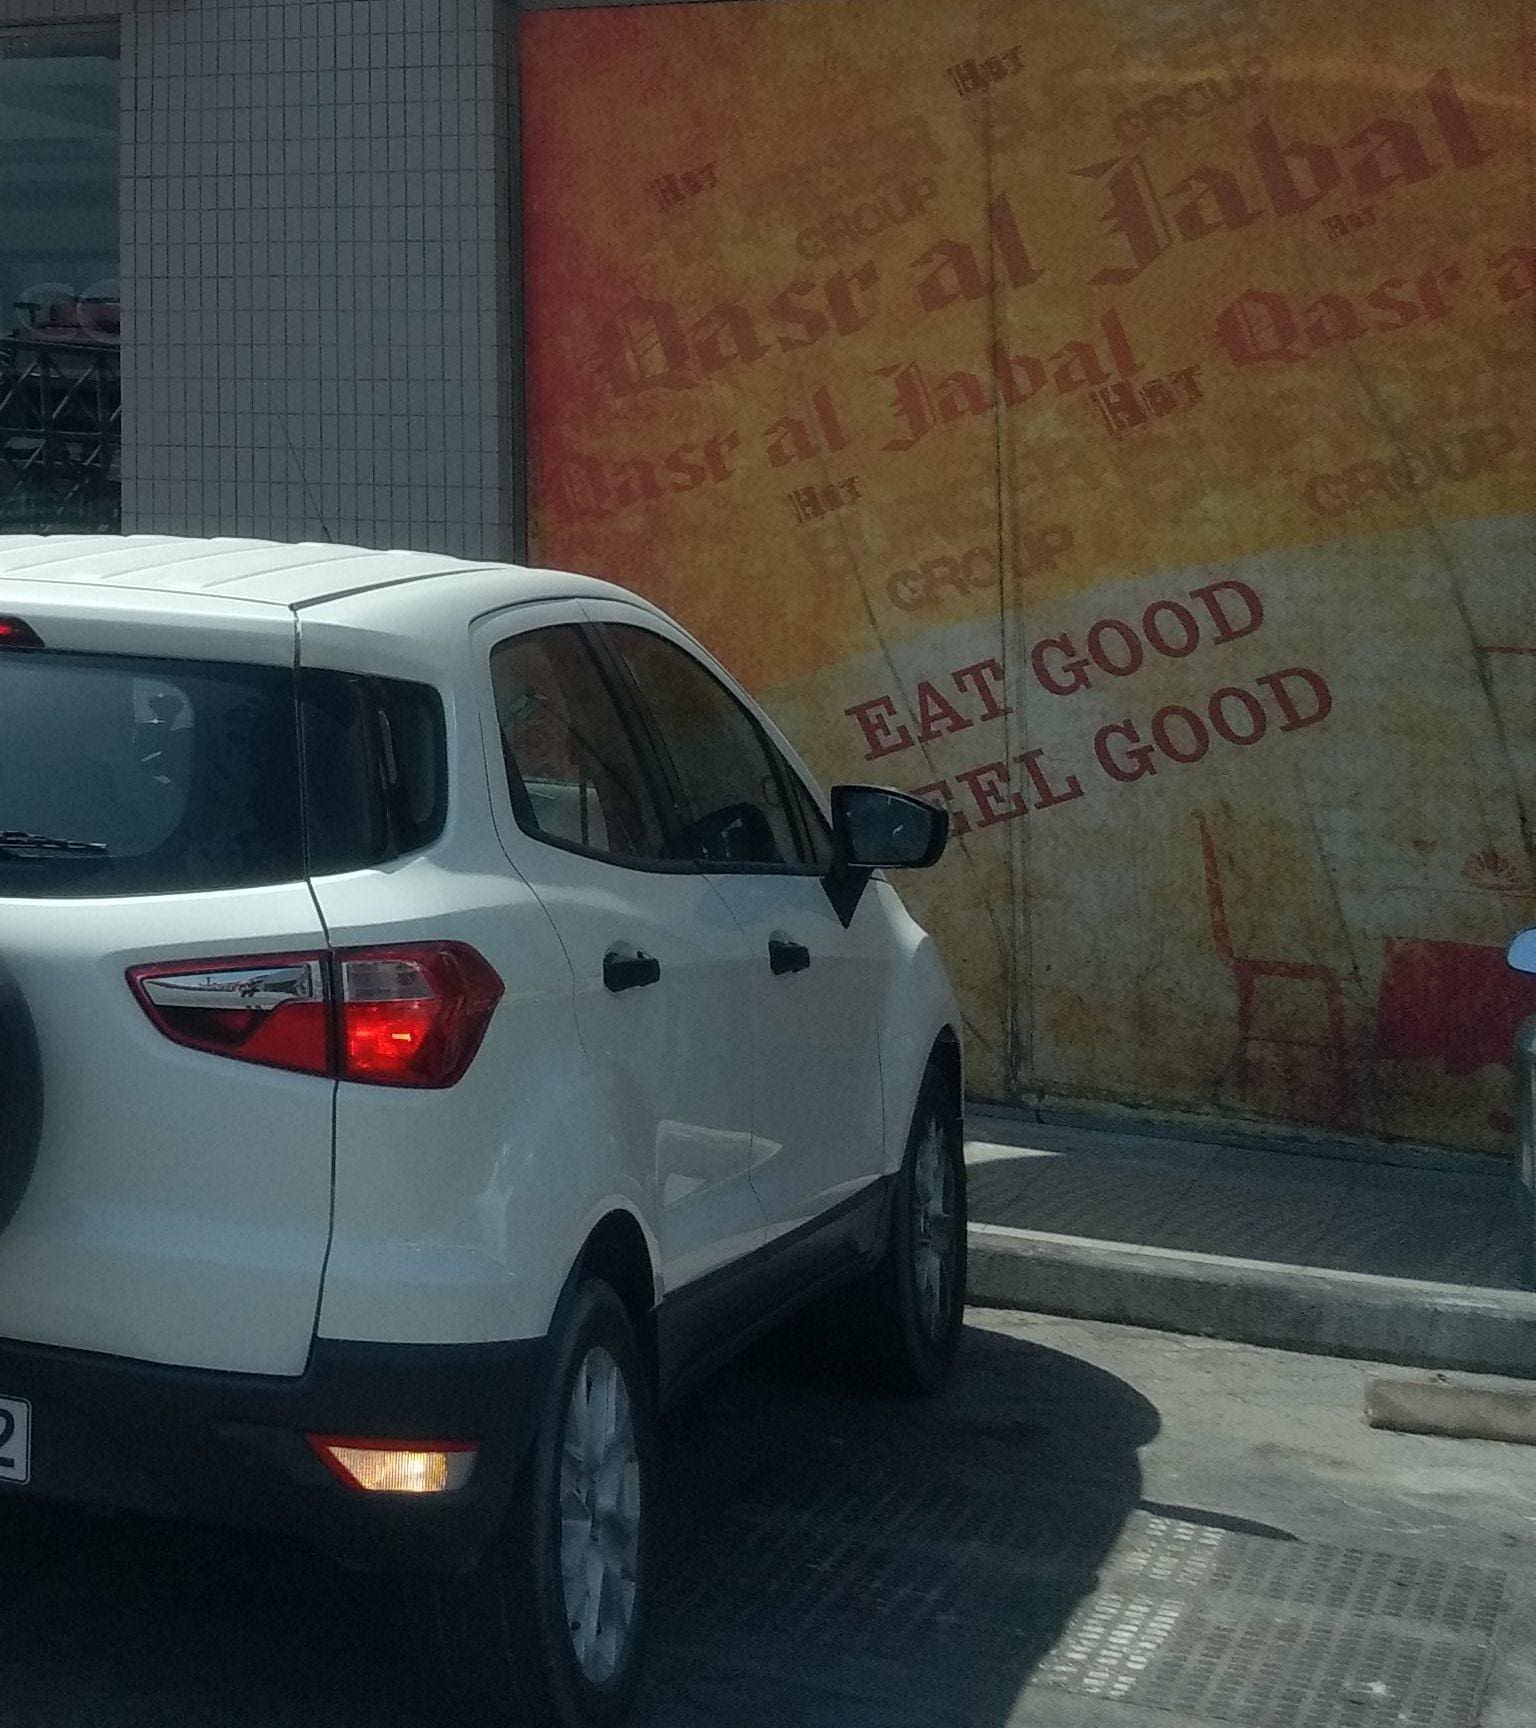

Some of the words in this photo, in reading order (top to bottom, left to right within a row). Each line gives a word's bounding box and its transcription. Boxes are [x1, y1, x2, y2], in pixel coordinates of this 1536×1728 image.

[591, 255, 882, 401] Qasr
[914, 190, 1044, 316] al
[1071, 66, 1494, 287] Jabal
[1209, 260, 1464, 368] Qasr
[766, 383, 849, 470] al
[874, 306, 1146, 454] Jabal
[845, 658, 1012, 762] EAT
[1030, 577, 1266, 698] GOOD
[1093, 666, 1333, 784] GOOD
